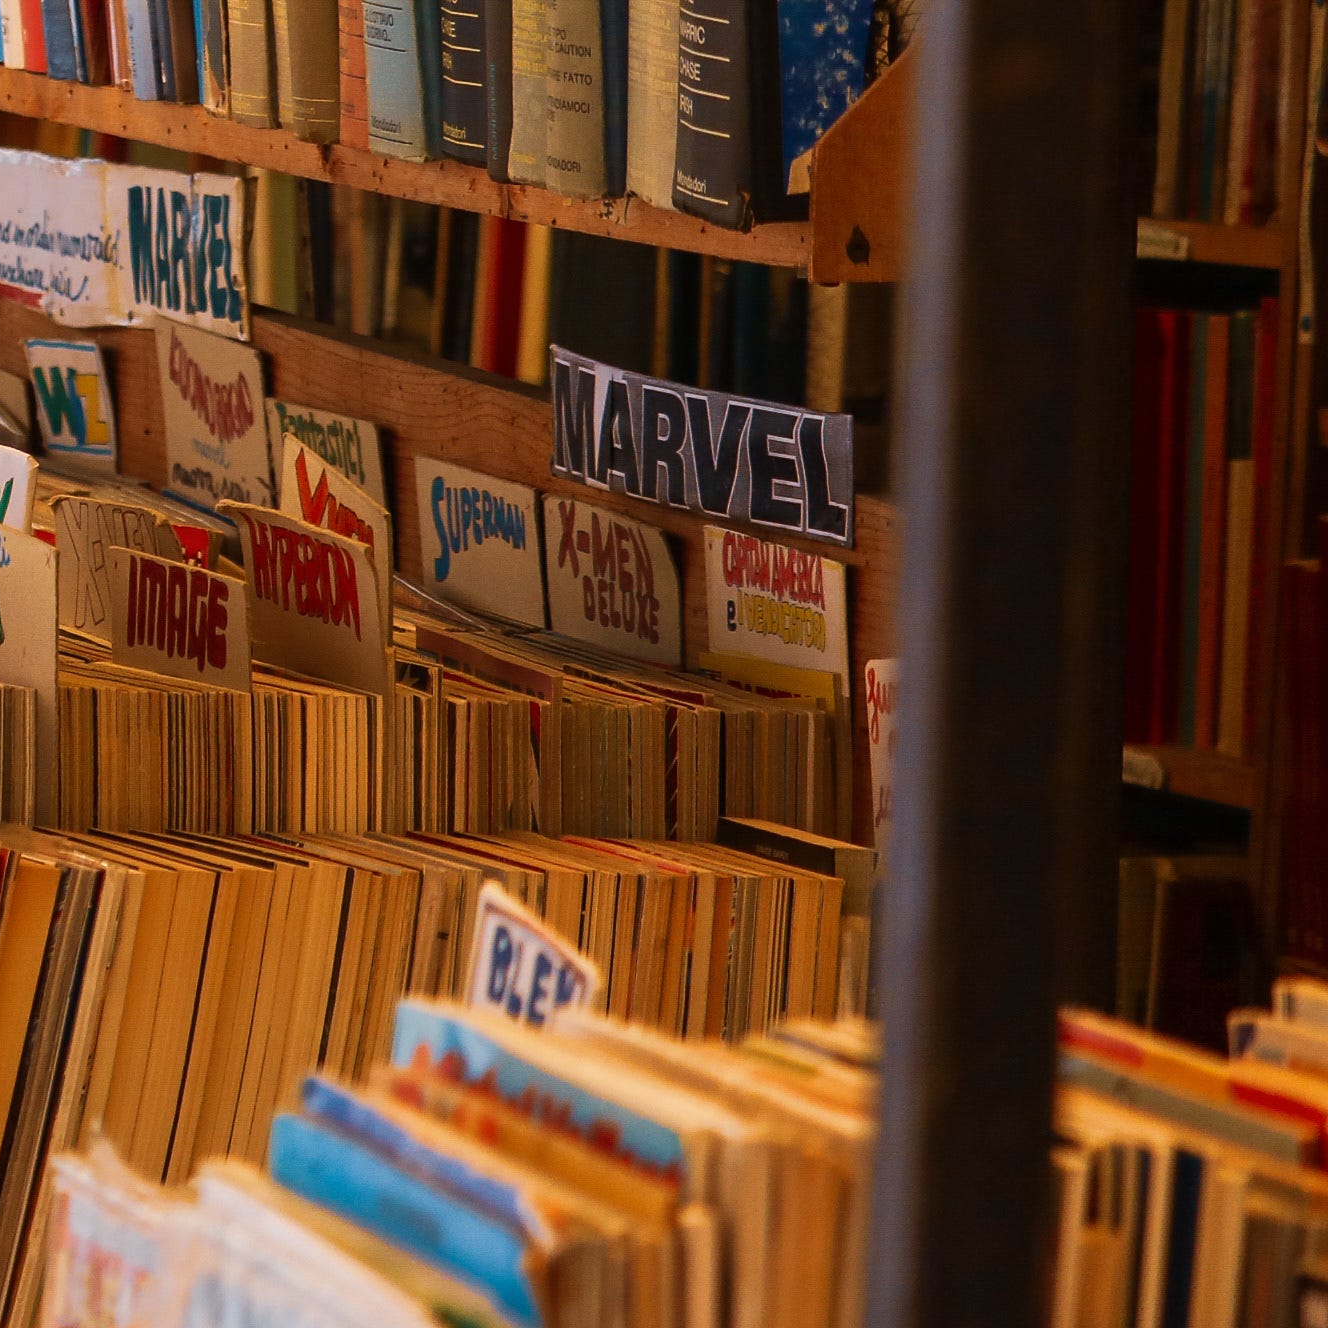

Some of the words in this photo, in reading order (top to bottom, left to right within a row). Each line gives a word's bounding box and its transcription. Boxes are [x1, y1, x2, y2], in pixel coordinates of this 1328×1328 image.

[127, 185, 242, 322] MARVEL
[553, 358, 848, 544] MARVEL
[239, 511, 362, 643] HYPERION
[432, 476, 525, 582] SUPERMAN
[558, 500, 654, 597] X-MEN
[722, 531, 770, 592] CAPITAN
[772, 544, 825, 611] AMERICA
[126, 556, 229, 671] IMAGE
[582, 576, 660, 644] DELUXE
